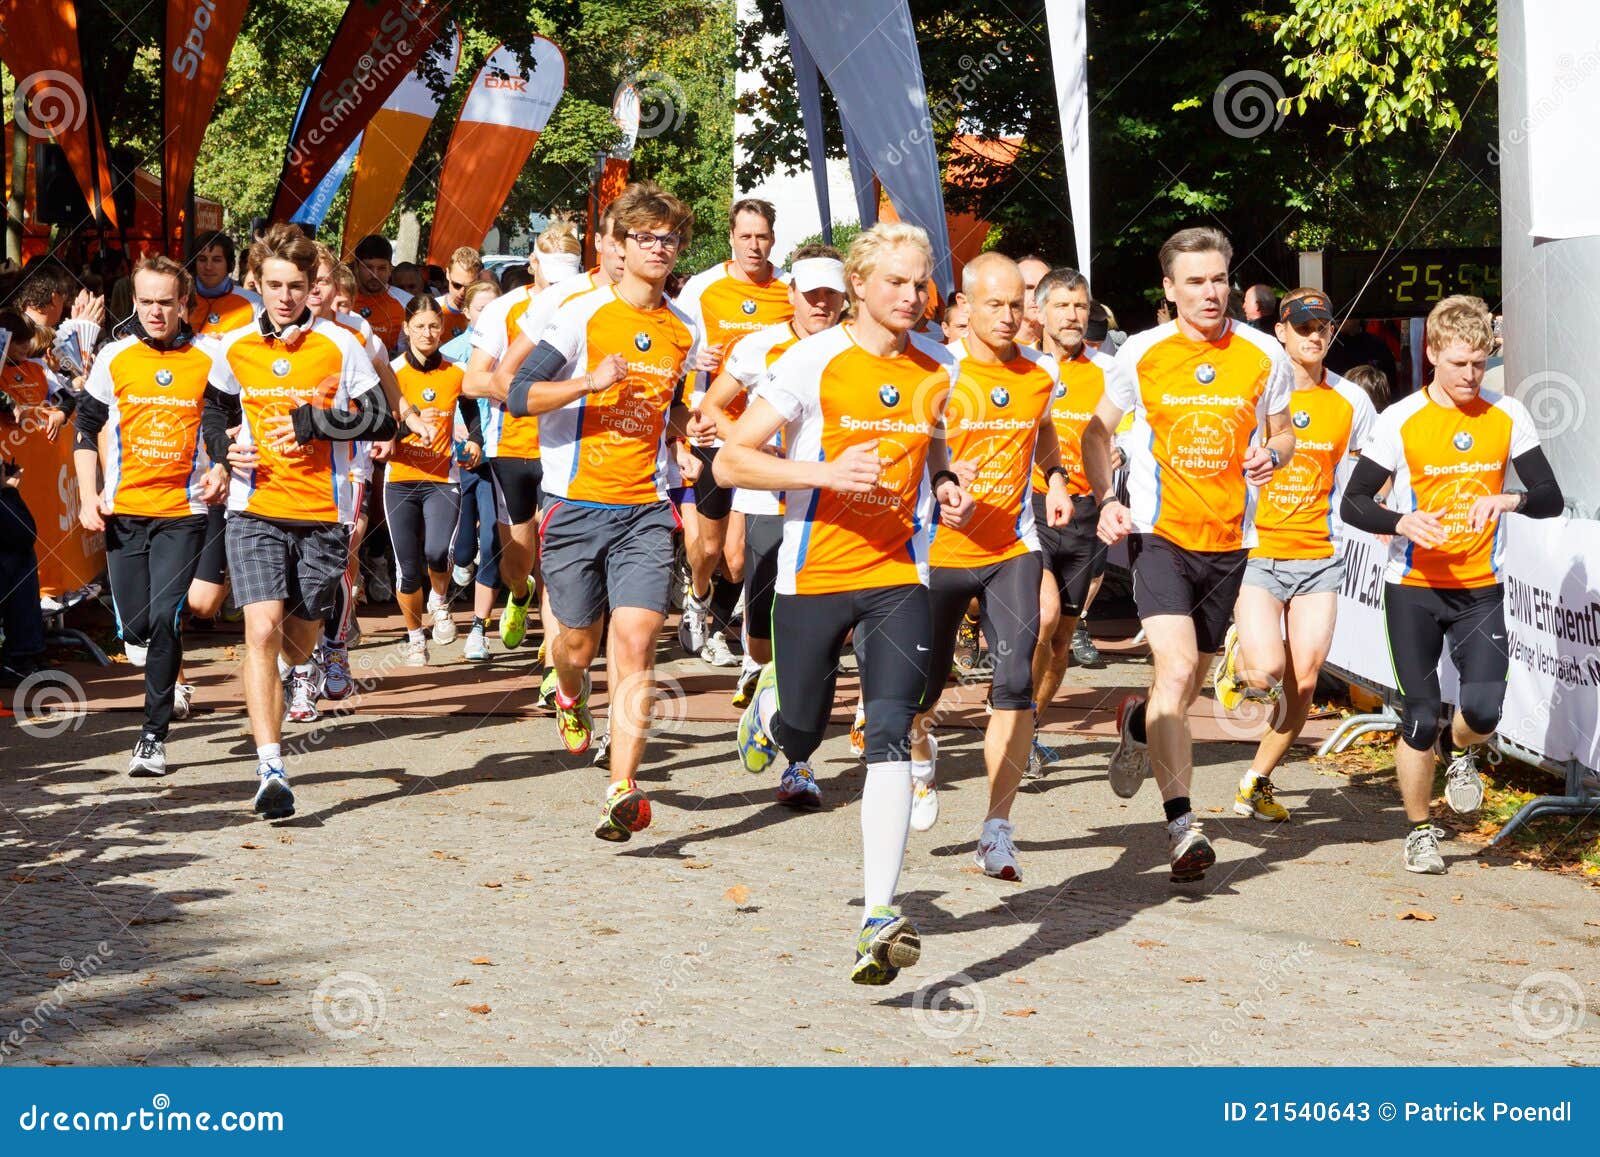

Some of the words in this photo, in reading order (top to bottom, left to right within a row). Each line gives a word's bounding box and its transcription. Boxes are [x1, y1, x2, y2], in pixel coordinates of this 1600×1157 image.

[484, 76, 528, 93] DAK
[627, 361, 674, 378] rtScheck
[247, 386, 320, 398] SportScheck
[127, 394, 198, 408] SportScheck
[1161, 393, 1245, 407] SportScheck
[840, 415, 929, 434] SportScheck
[137, 436, 177, 447] Stadtlauf
[131, 444, 182, 461] Freiburg
[1177, 445, 1224, 455] Stadtlauf
[1171, 456, 1229, 470] Freiburg
[1423, 460, 1503, 476] SportScheck
[967, 481, 1015, 495] reiburg
[837, 490, 901, 507] Freiburg
[1508, 575, 1532, 626] BMW
